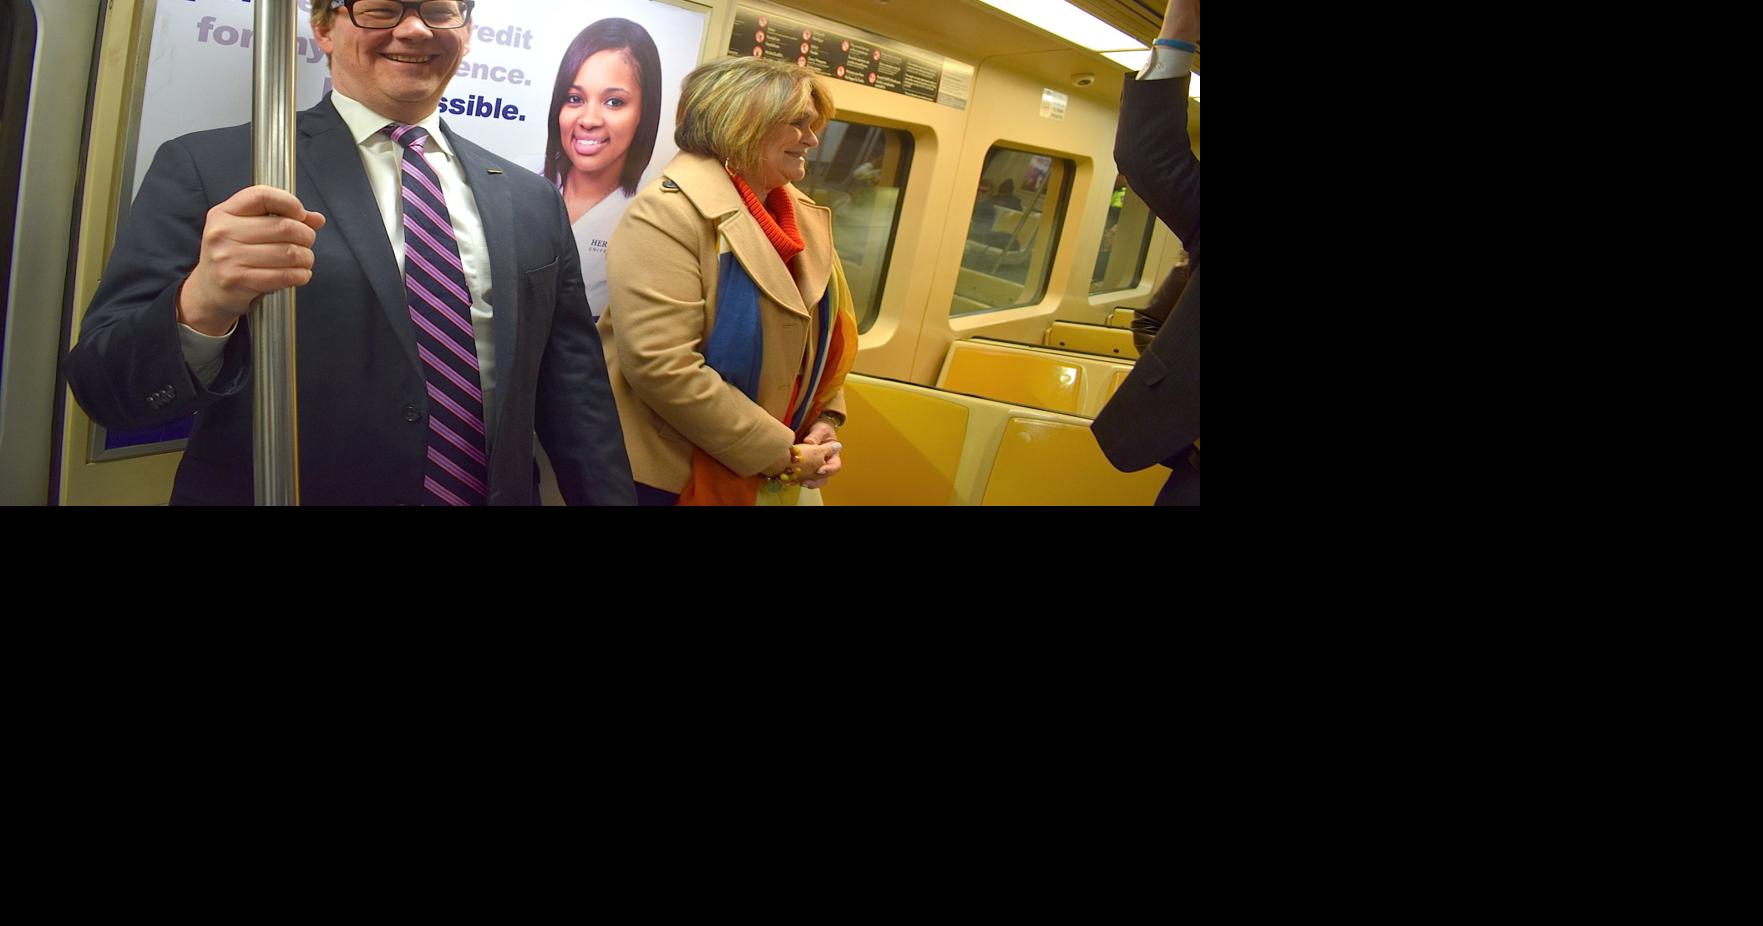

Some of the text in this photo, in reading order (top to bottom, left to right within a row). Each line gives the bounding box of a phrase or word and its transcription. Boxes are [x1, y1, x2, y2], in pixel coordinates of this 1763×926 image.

[196, 15, 255, 48] for
[455, 60, 532, 86] ence.
[438, 94, 526, 122] ssible.
[590, 239, 608, 248] HER
